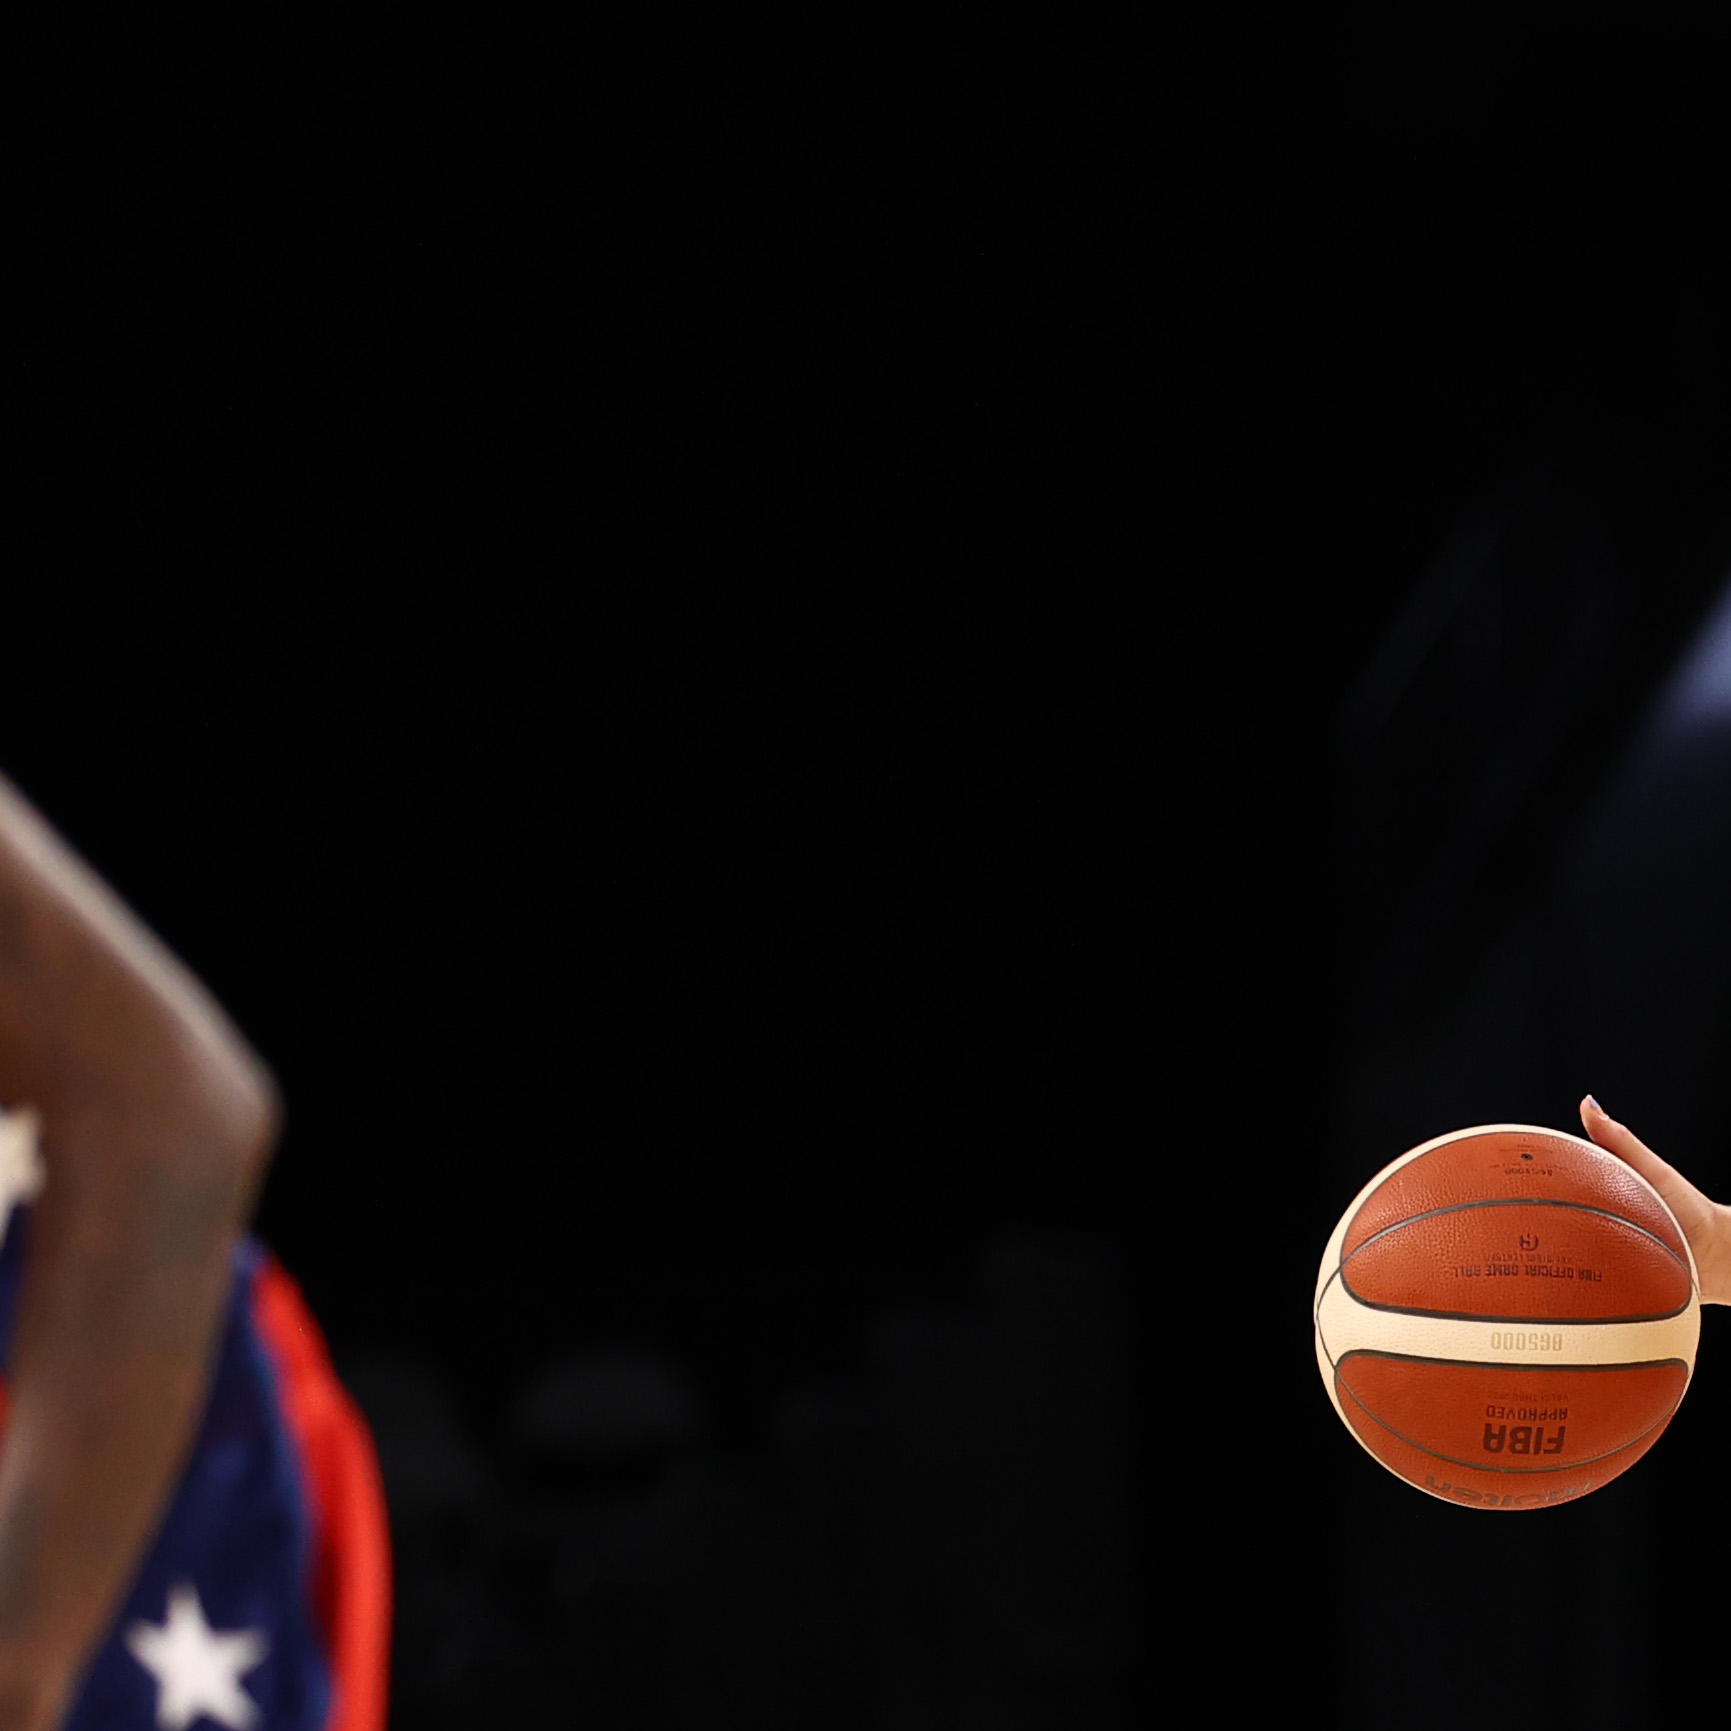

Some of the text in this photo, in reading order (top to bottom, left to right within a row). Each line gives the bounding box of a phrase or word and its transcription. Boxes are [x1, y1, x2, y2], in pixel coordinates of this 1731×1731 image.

[1452, 1263, 1603, 1282] FIBA OFFICIAL GAME BALL
[1490, 1332, 1563, 1352] BG5000
[1486, 1405, 1568, 1421] APPROVED
[1482, 1423, 1566, 1455] FIBA
